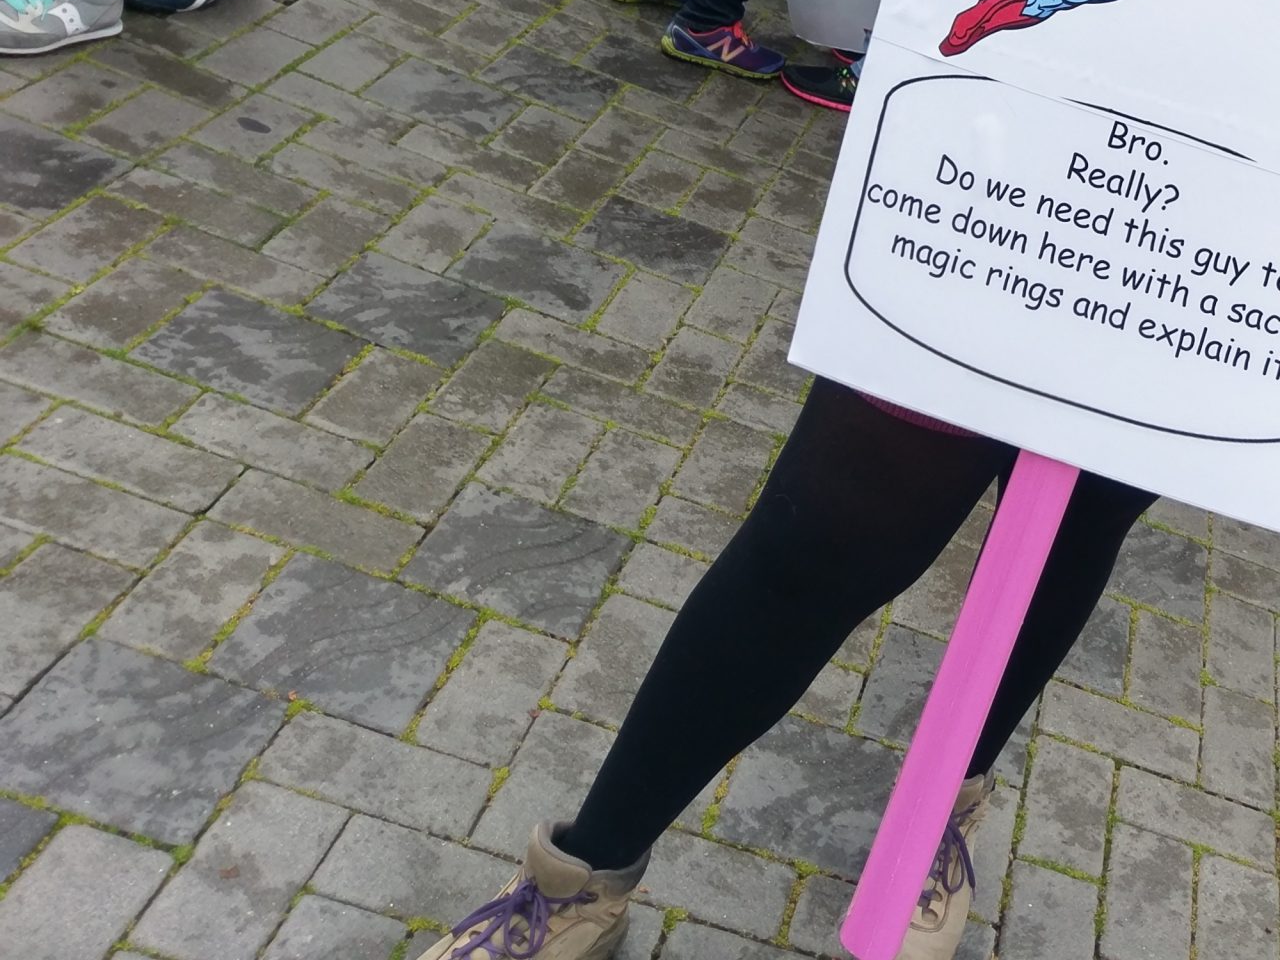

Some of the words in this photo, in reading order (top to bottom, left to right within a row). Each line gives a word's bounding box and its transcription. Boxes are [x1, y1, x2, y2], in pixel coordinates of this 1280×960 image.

[1067, 152, 1180, 213] Really?
[1107, 120, 1169, 165] Bro.
[867, 183, 941, 224] come
[951, 206, 1028, 254] down
[1038, 231, 1111, 280] here
[1121, 266, 1190, 308] with
[1199, 294, 1219, 316] a
[936, 154, 975, 190] Do
[986, 178, 1026, 207] we
[1036, 195, 1115, 236] need
[1124, 218, 1185, 259] this
[1190, 247, 1251, 286] guy
[891, 234, 977, 278] magic
[985, 265, 1064, 311] rings
[1073, 298, 1131, 331] and
[1138, 318, 1251, 371] explain
